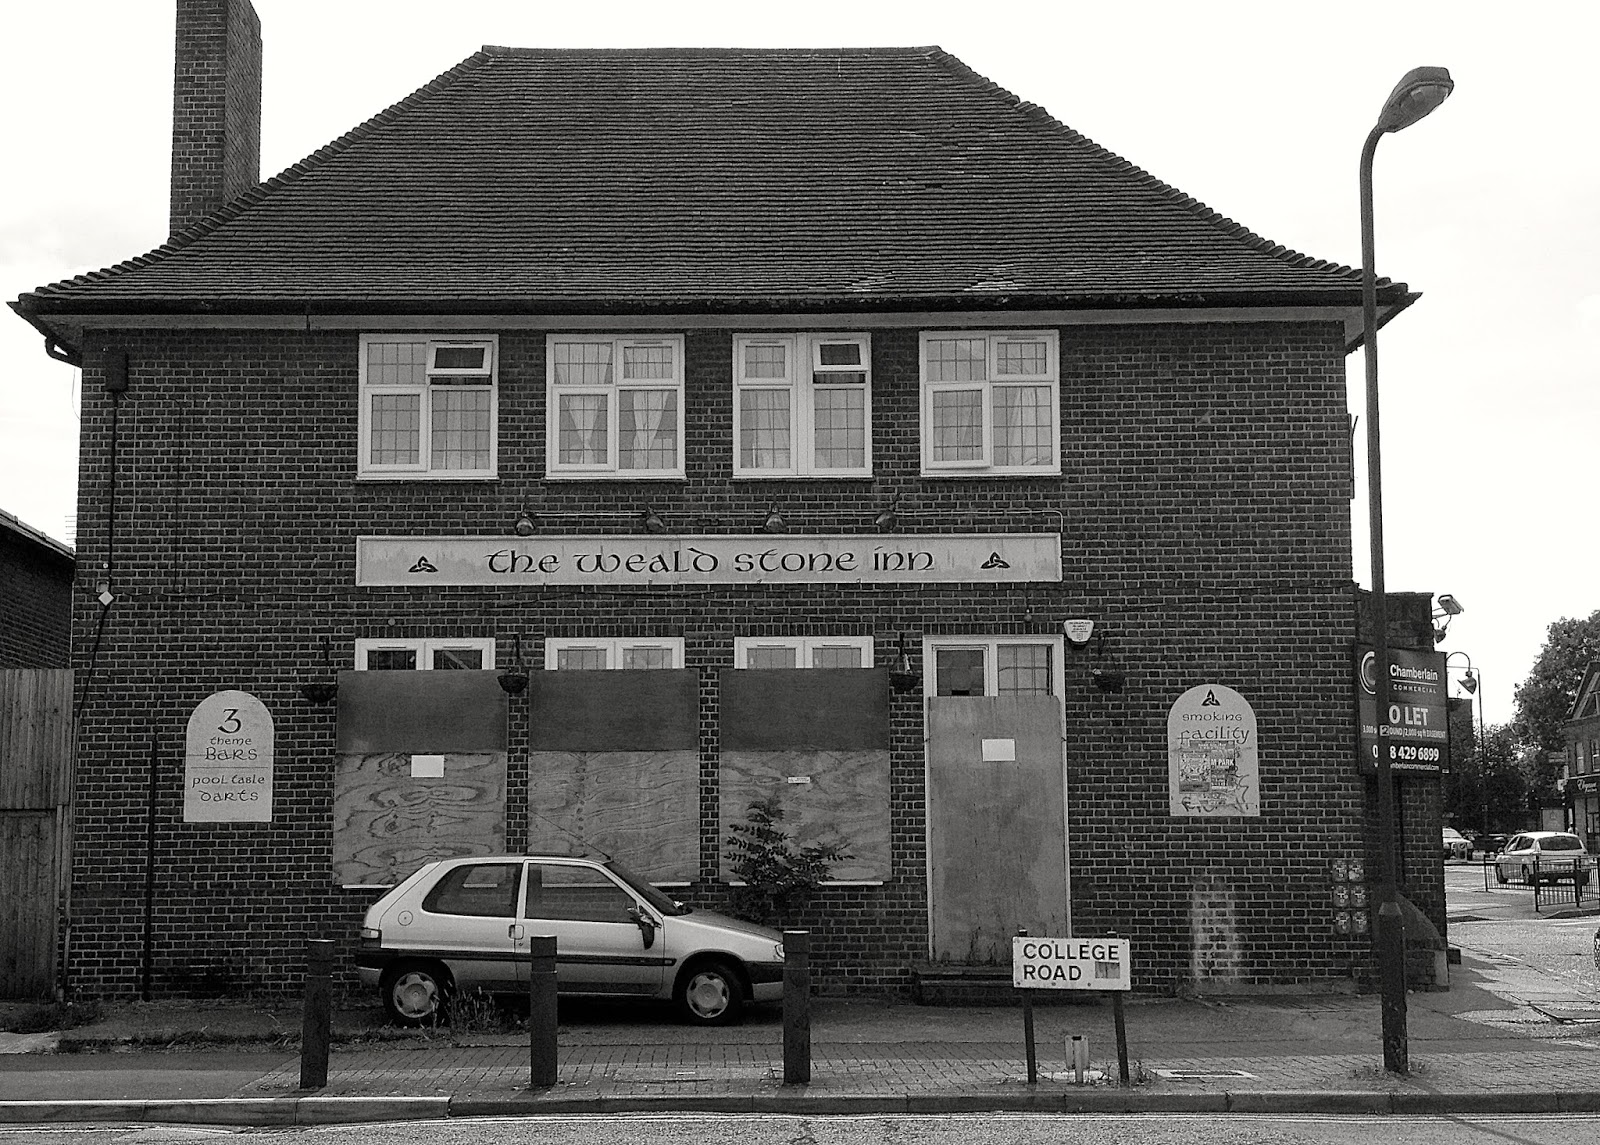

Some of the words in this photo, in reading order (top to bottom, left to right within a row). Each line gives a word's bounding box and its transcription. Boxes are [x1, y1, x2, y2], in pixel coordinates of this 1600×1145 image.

[483, 549, 561, 574] the
[573, 547, 719, 574] weald
[734, 549, 859, 573] stone
[1390, 664, 1438, 680] Chamberlain
[1393, 684, 1437, 693] COMMERCIAL
[217, 708, 242, 734] 3
[1182, 711, 1243, 722] smoking
[1404, 706, 1429, 726] LET
[1177, 726, 1249, 745] facility
[1381, 726, 1389, 735] 2
[210, 736, 252, 746] theme
[1398, 746, 1417, 760] 429
[1418, 747, 1440, 761] 6899
[1023, 943, 1120, 961] COLLEGE
[1023, 964, 1082, 981] ROAD
